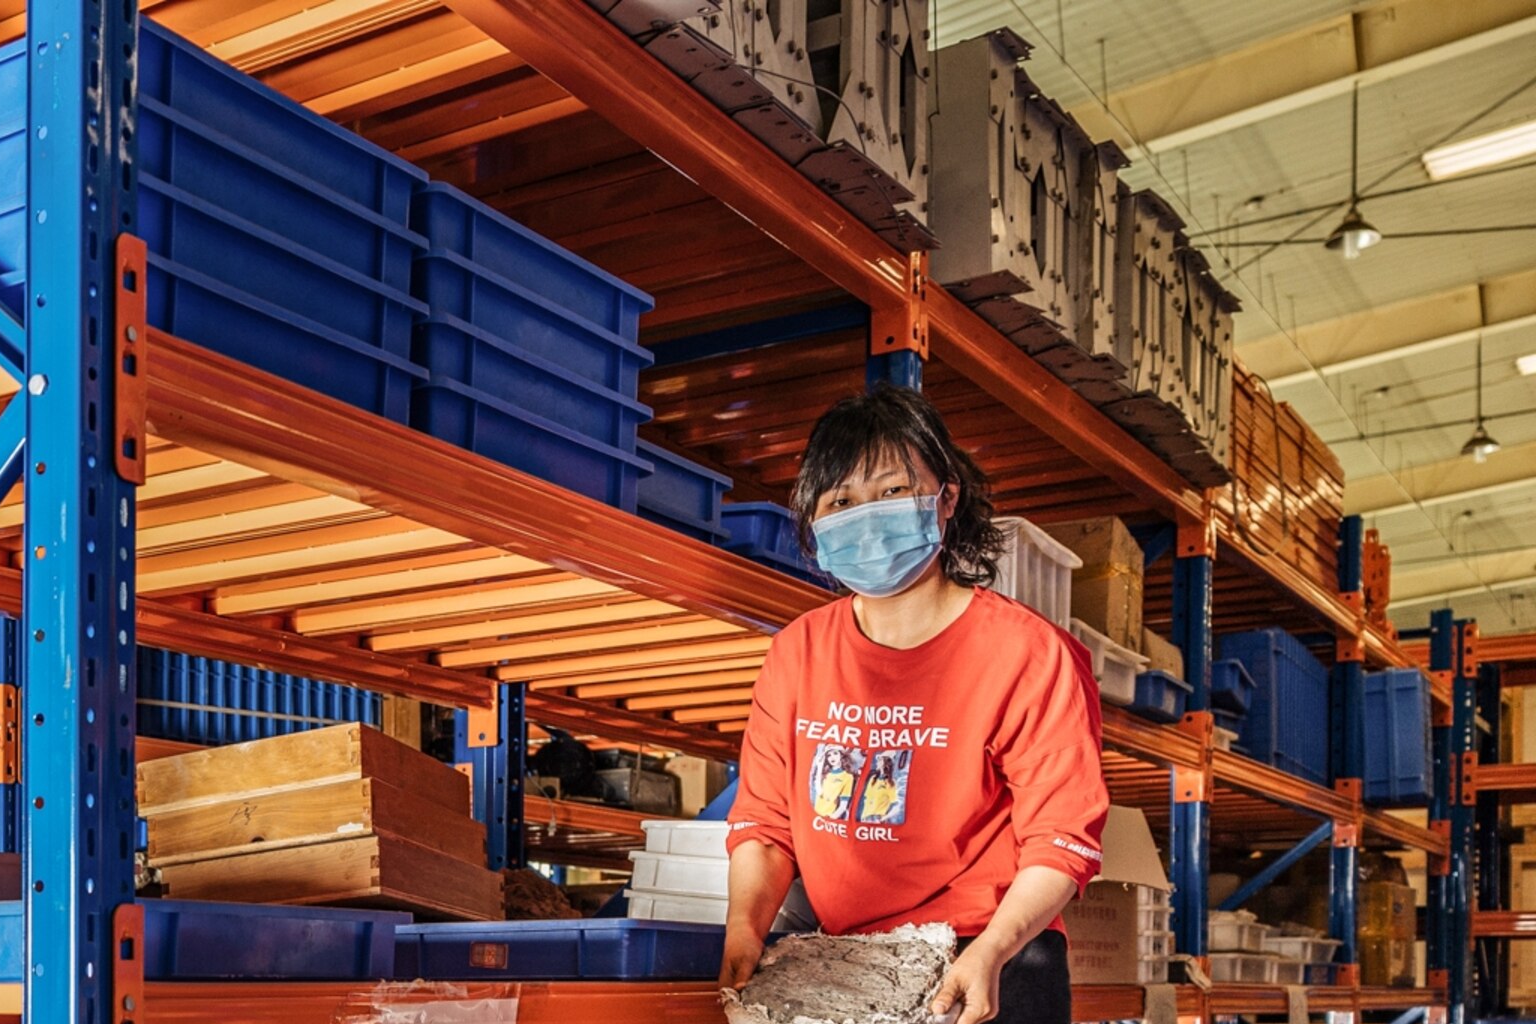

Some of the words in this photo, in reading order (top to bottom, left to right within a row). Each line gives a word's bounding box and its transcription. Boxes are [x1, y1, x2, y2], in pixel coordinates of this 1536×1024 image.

[828, 701, 862, 723] NO
[796, 719, 862, 746] FEAR
[868, 727, 949, 748] BRAVE
[855, 826, 899, 841] GIRL
